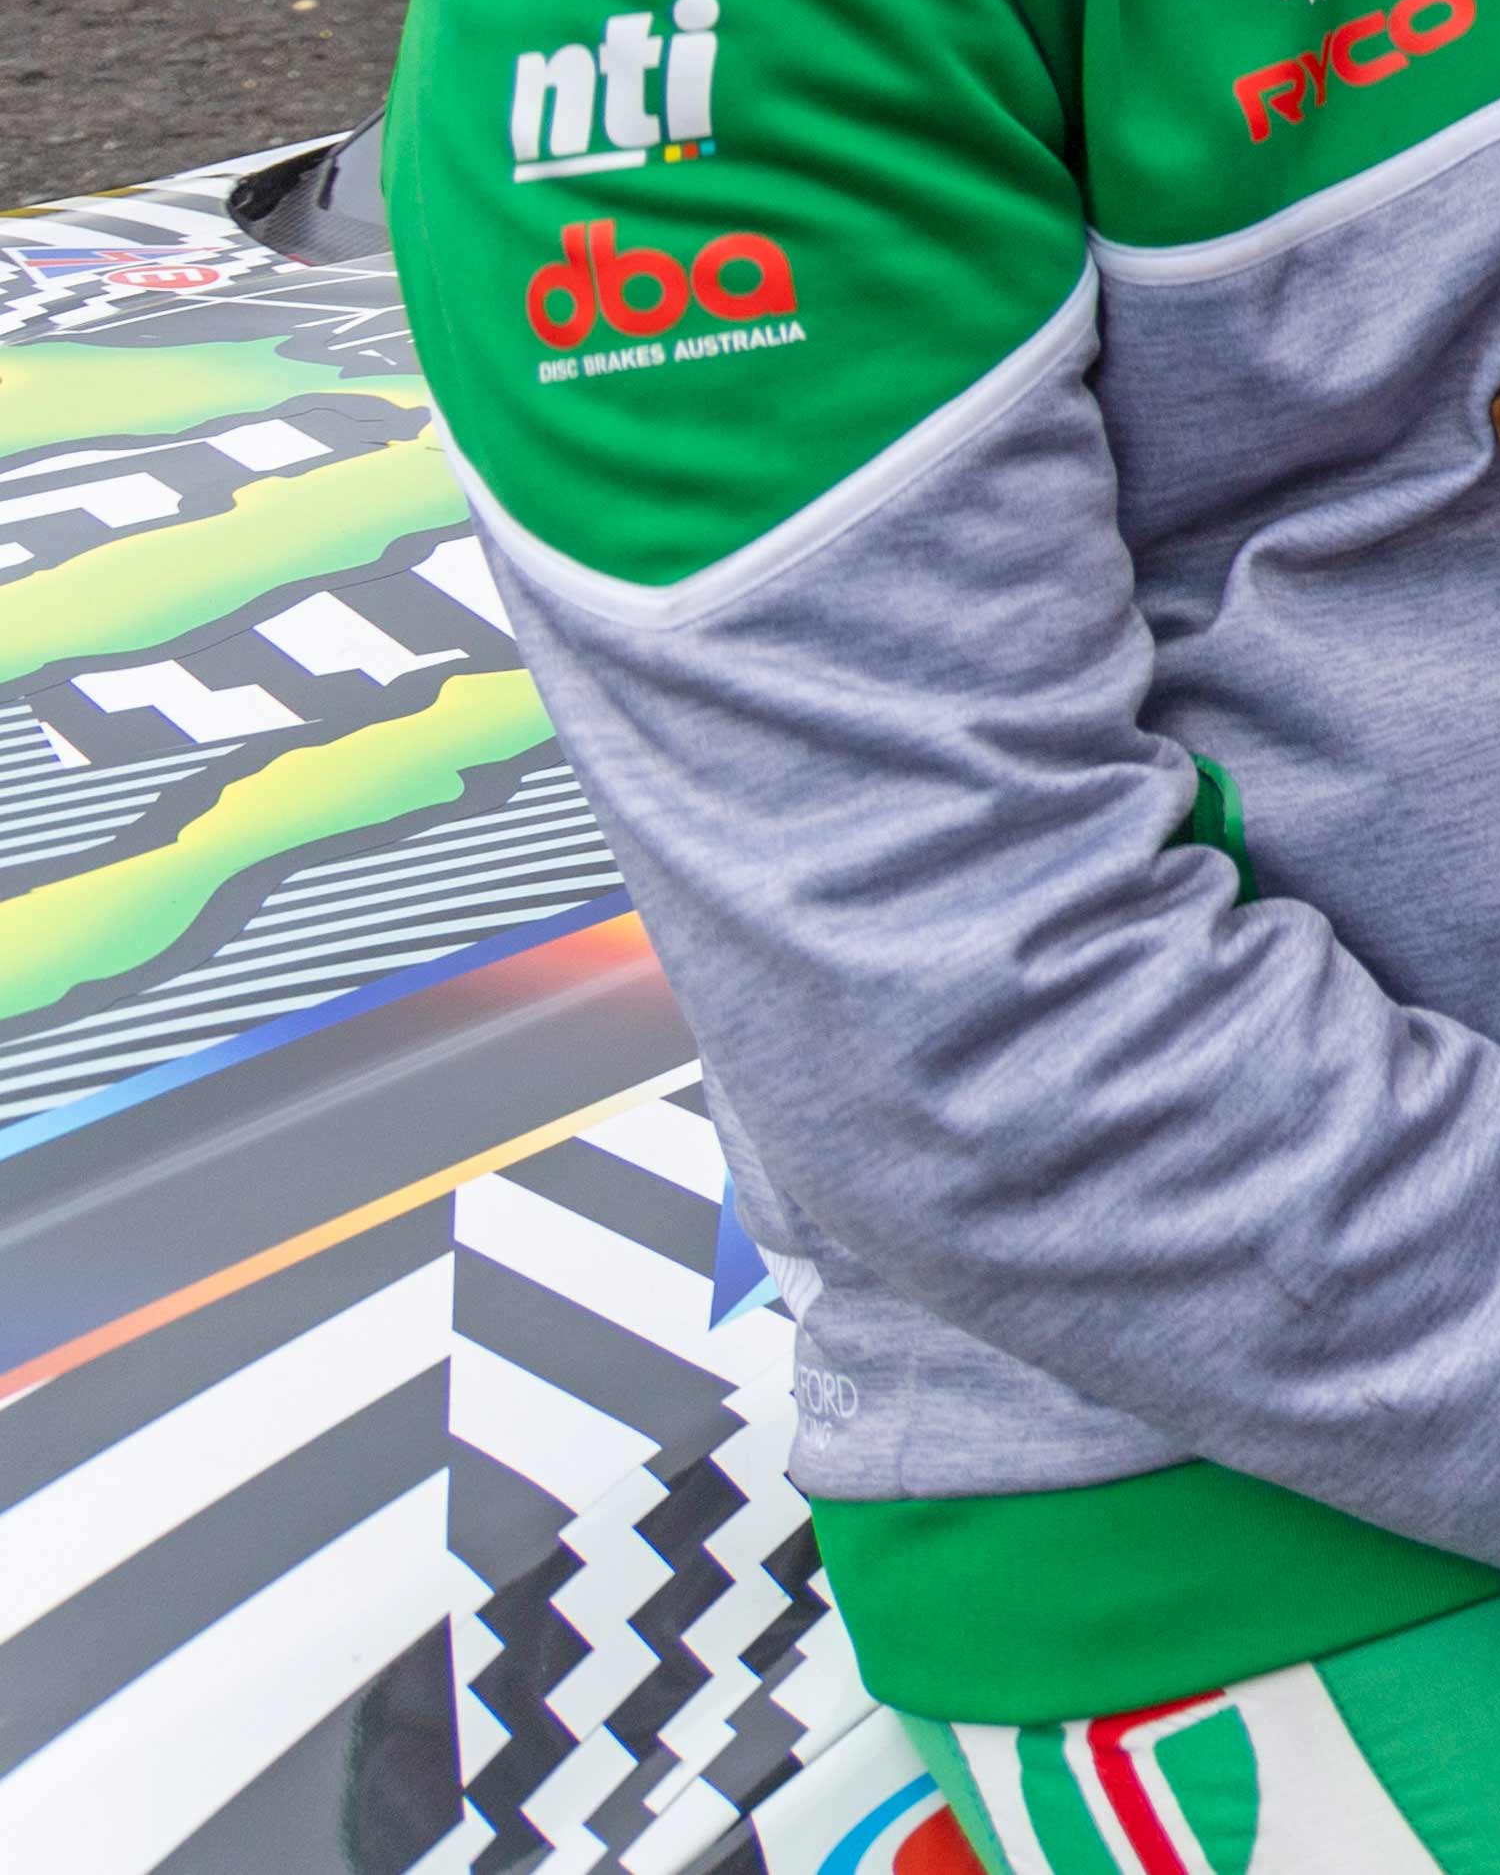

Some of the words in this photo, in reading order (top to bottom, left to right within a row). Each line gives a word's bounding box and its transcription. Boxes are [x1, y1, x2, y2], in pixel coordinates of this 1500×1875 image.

[526, 218, 798, 350] dba
[538, 358, 579, 385] DISC
[583, 344, 665, 377] BRAKES
[673, 321, 806, 365] AUSTRALIA
